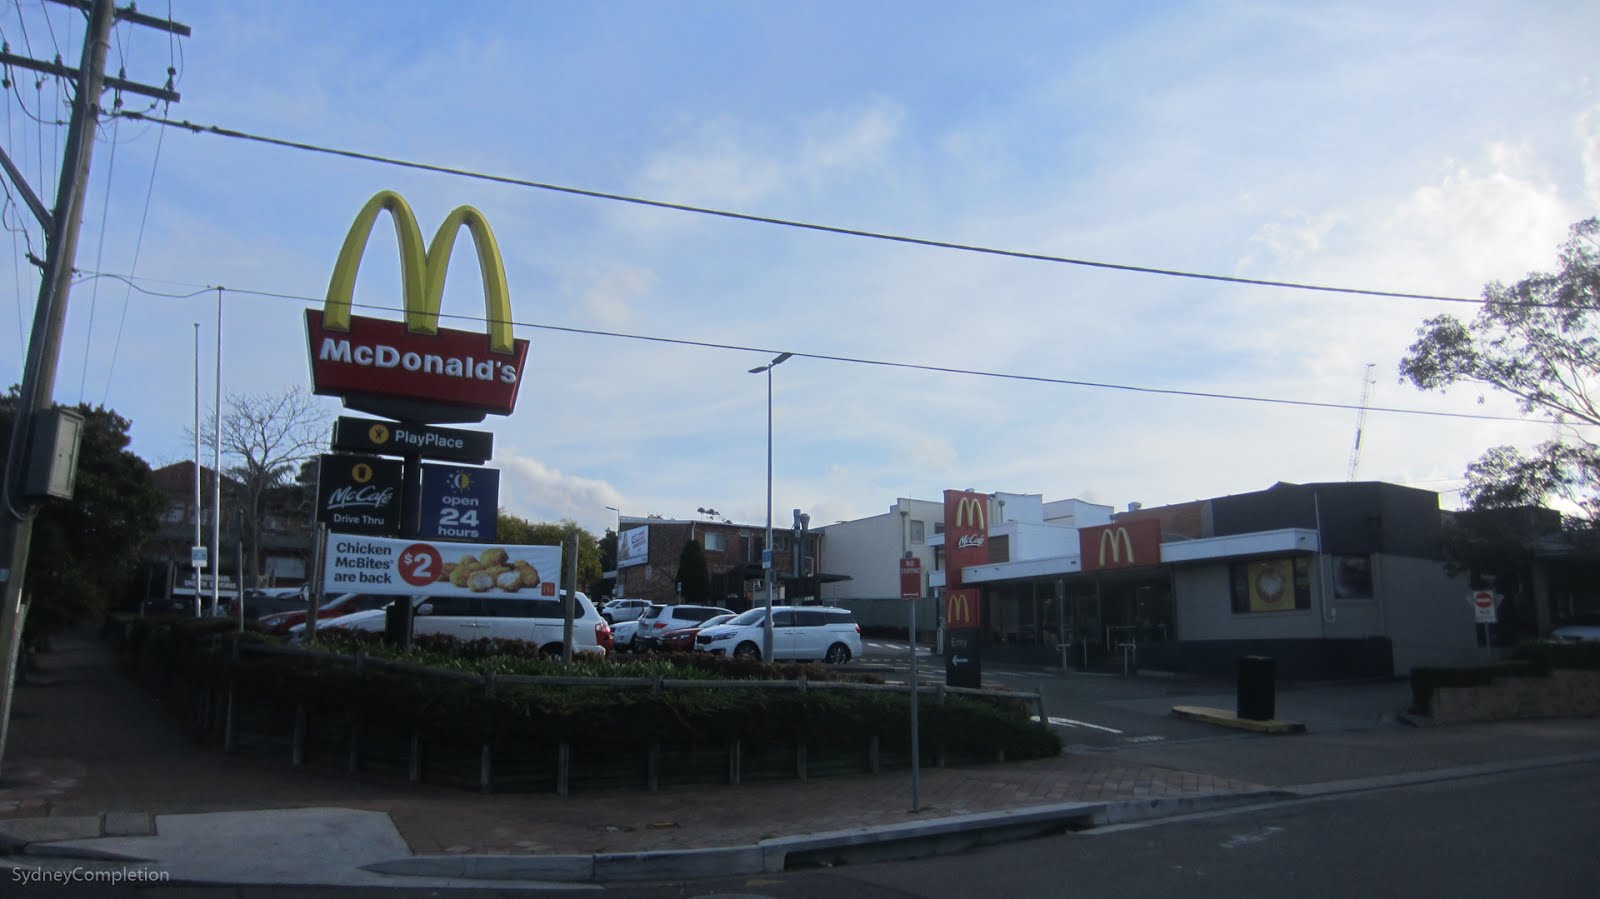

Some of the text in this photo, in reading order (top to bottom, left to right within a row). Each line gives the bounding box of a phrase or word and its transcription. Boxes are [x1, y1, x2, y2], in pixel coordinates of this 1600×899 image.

[319, 337, 517, 385] McDonald's
[395, 429, 464, 448] PlayPlace
[442, 495, 480, 507] open
[333, 513, 385, 525] Drive Thru
[439, 508, 480, 527] 24
[438, 526, 480, 538] hours
[336, 541, 393, 556] Chicken
[404, 552, 433, 578] $2
[334, 572, 392, 584] are back
